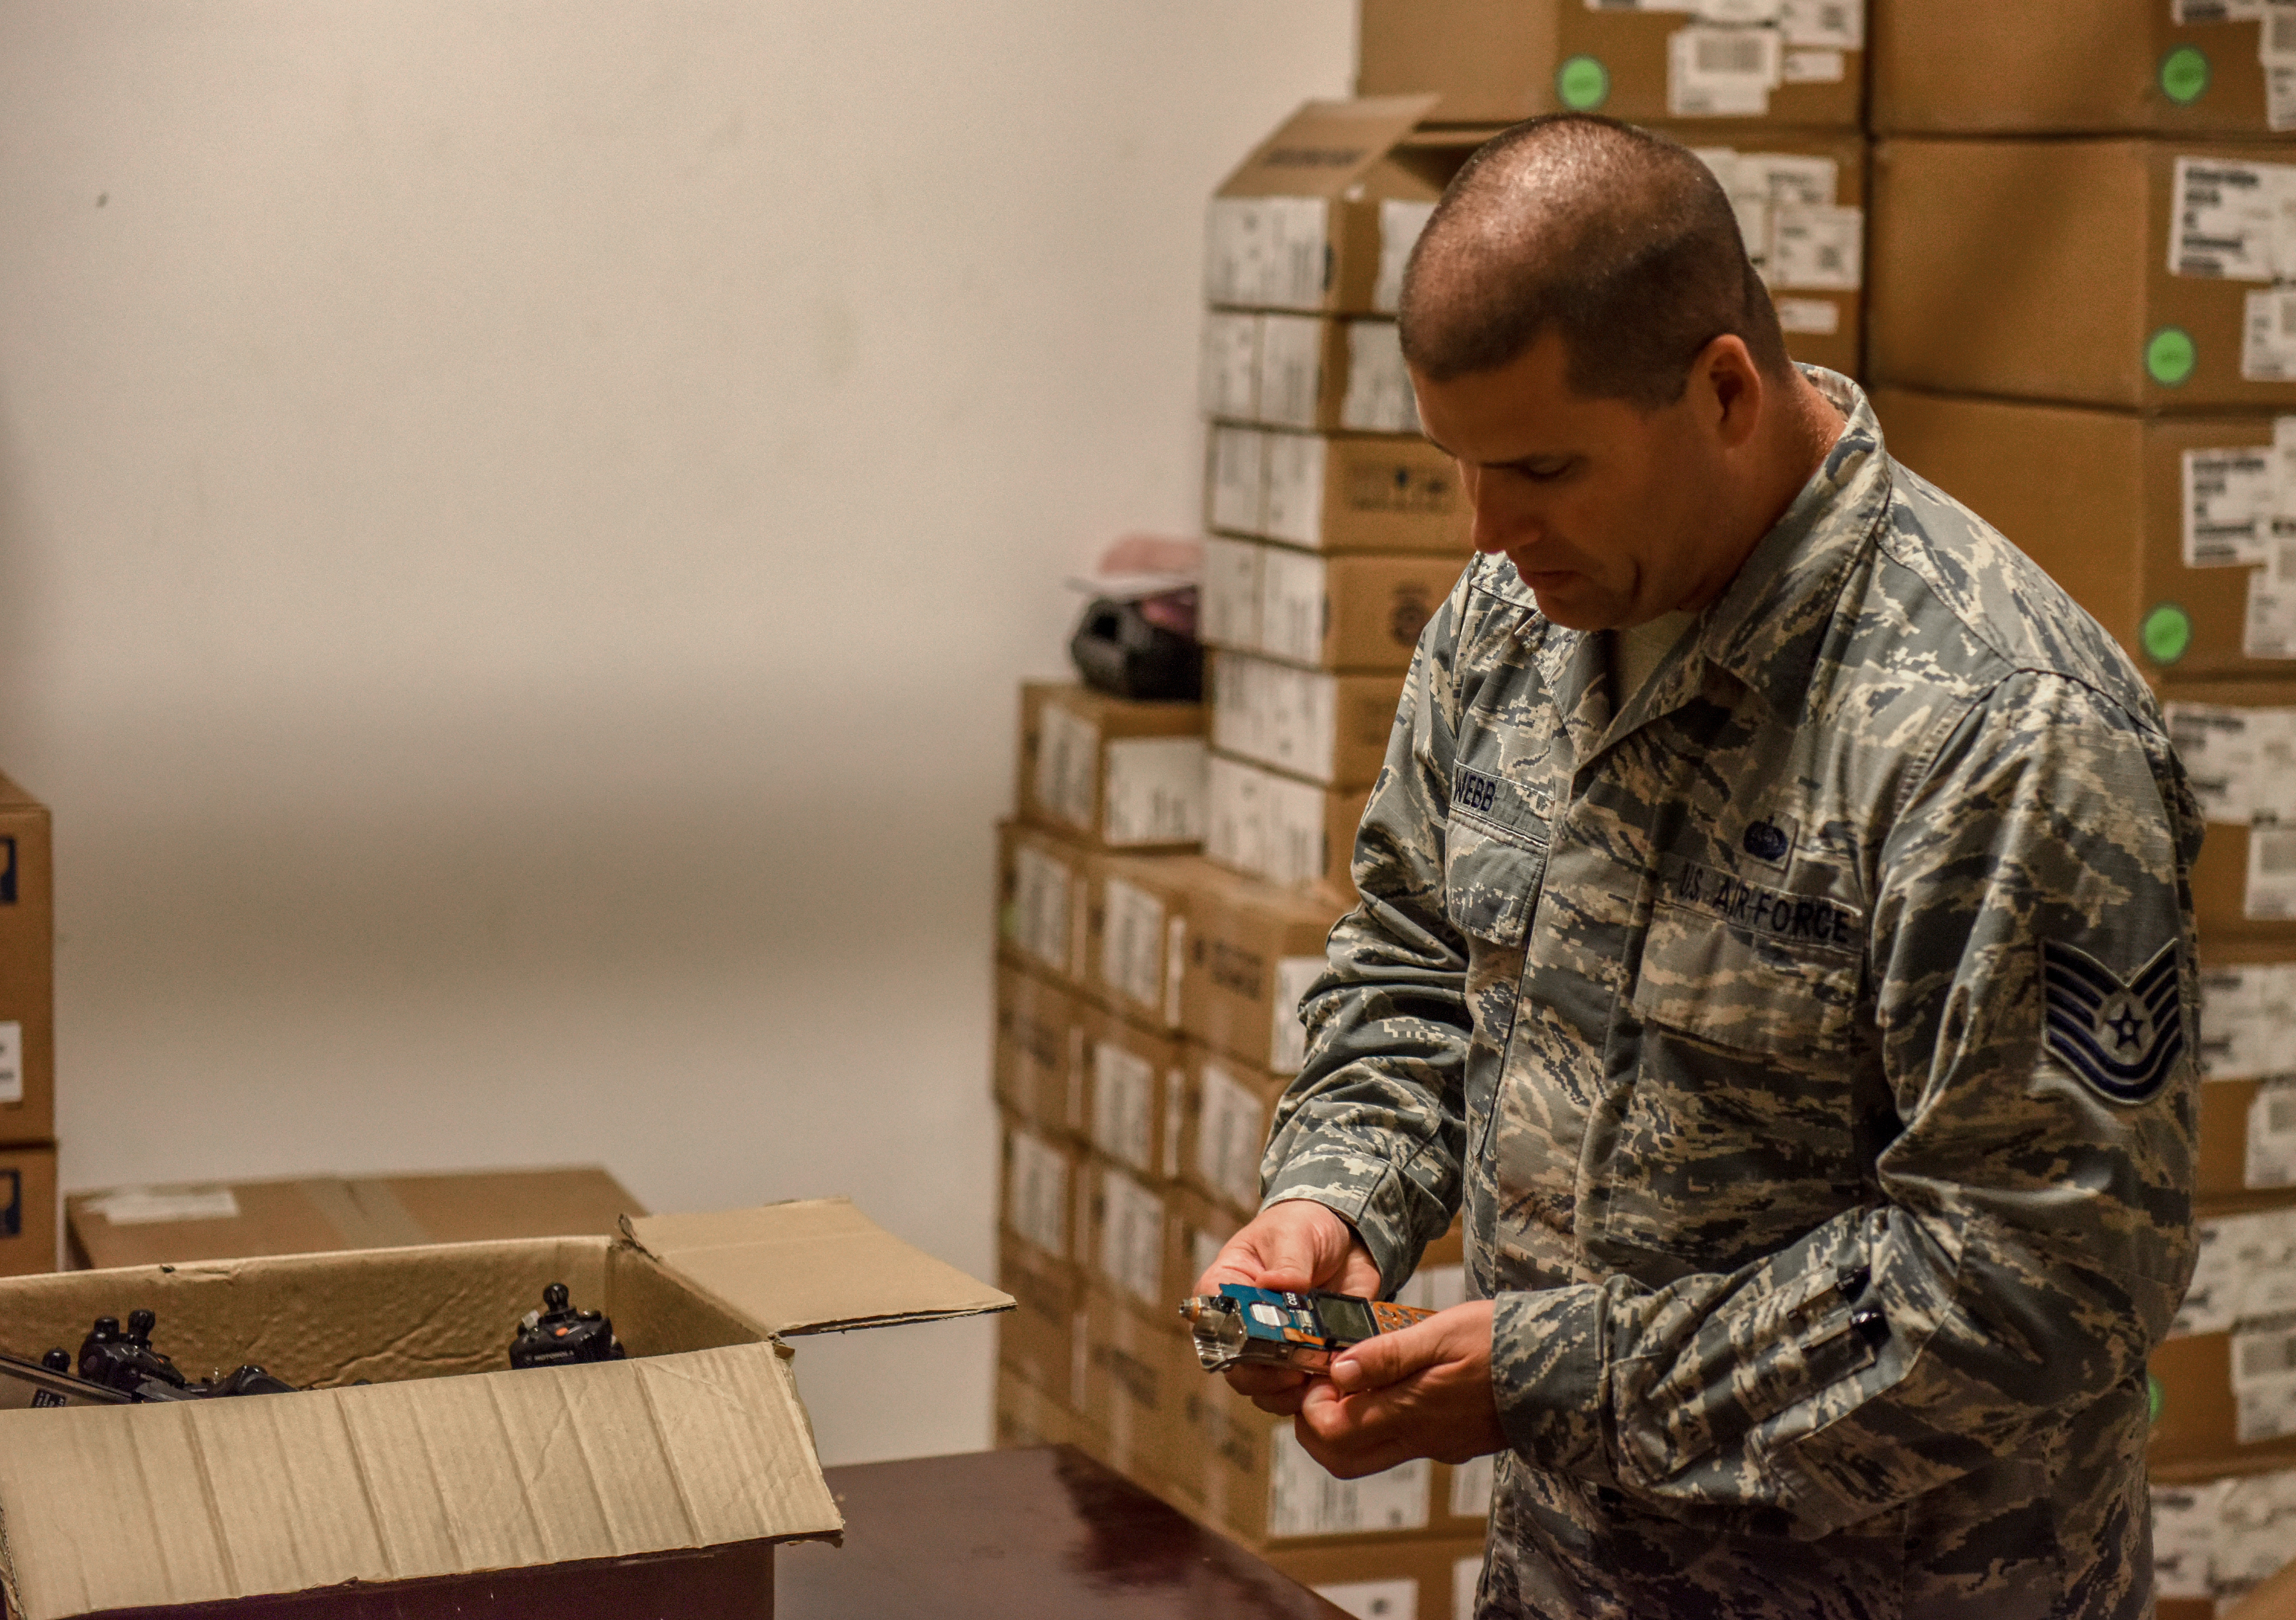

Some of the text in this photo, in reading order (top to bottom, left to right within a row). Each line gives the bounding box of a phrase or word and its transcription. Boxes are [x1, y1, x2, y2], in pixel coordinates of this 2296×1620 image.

[1453, 768, 1495, 812] WEBB
[1713, 877, 1750, 919] AIR
[1754, 894, 1850, 943] FORCE
